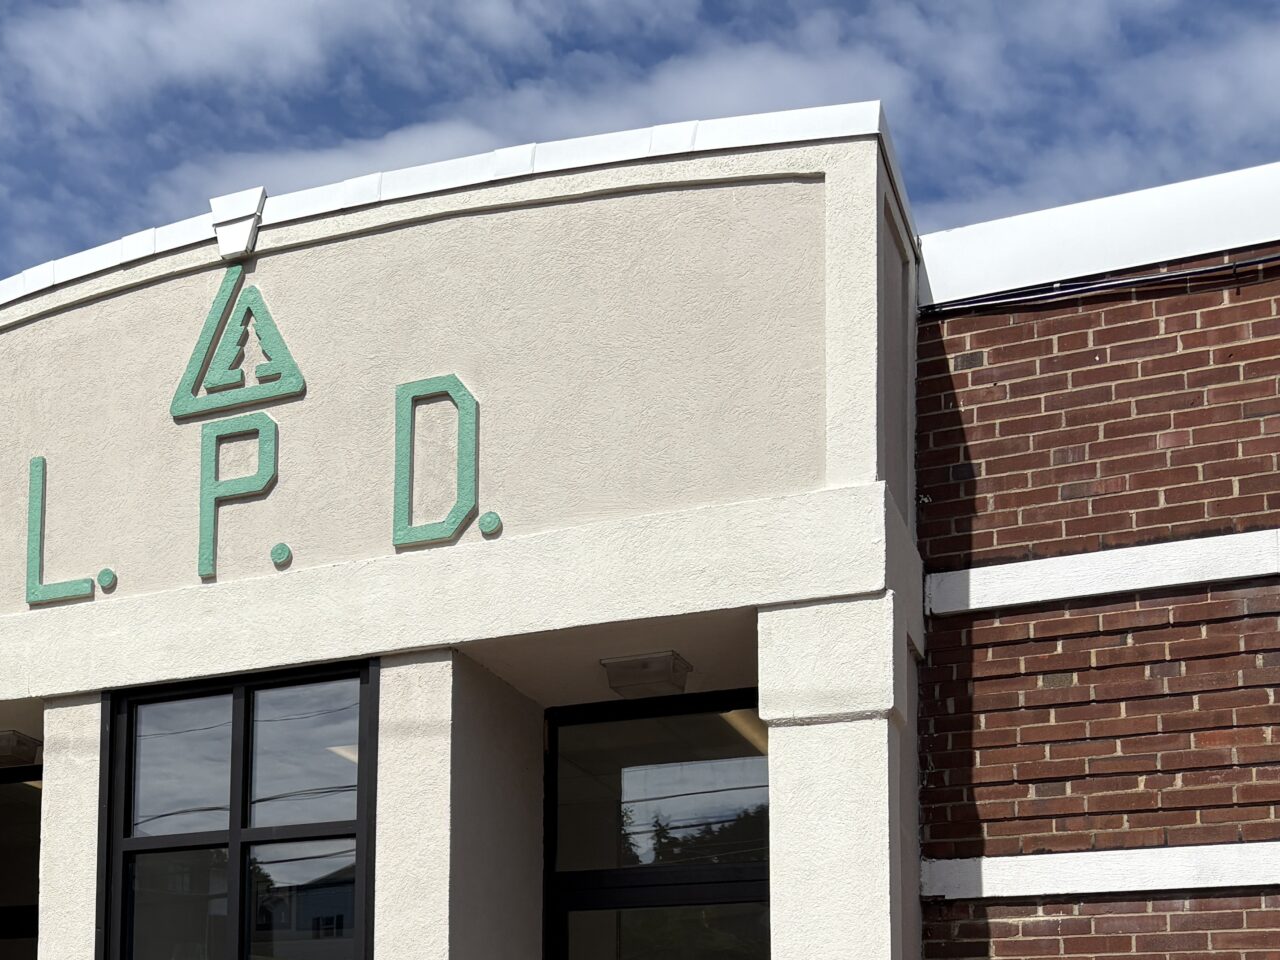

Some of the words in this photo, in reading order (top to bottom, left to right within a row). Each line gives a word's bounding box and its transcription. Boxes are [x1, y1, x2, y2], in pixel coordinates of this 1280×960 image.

[26, 456, 116, 604] L.
[198, 412, 293, 578] P.
[393, 374, 503, 547] D.
